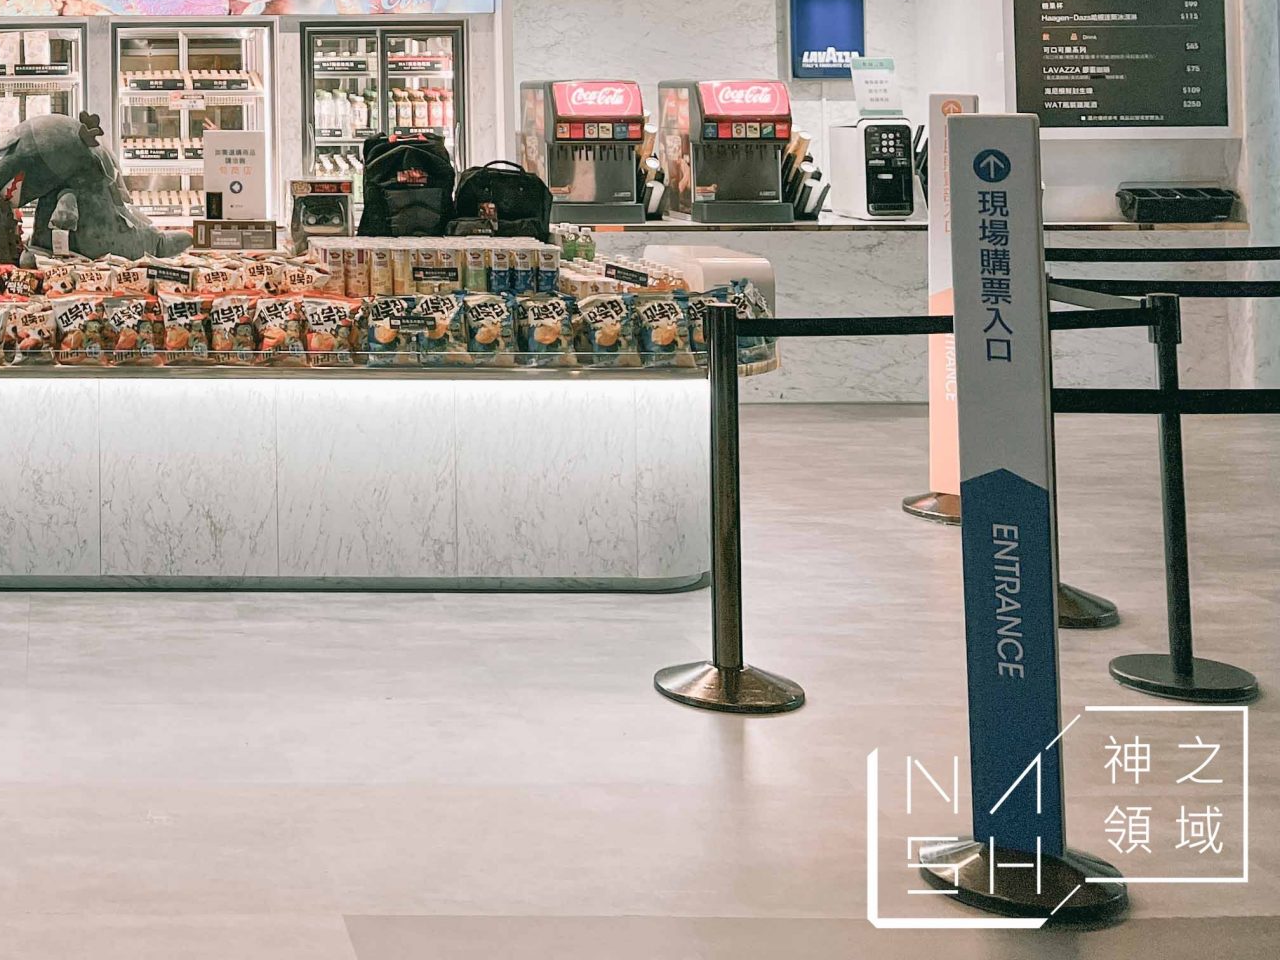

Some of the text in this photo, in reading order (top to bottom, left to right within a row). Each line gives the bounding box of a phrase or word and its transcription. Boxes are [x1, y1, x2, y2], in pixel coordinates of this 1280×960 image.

[1042, 66, 1081, 74] LAVAZZA
[977, 190, 1013, 363] 現場購票入口
[992, 523, 1025, 679] ENTRANCE
